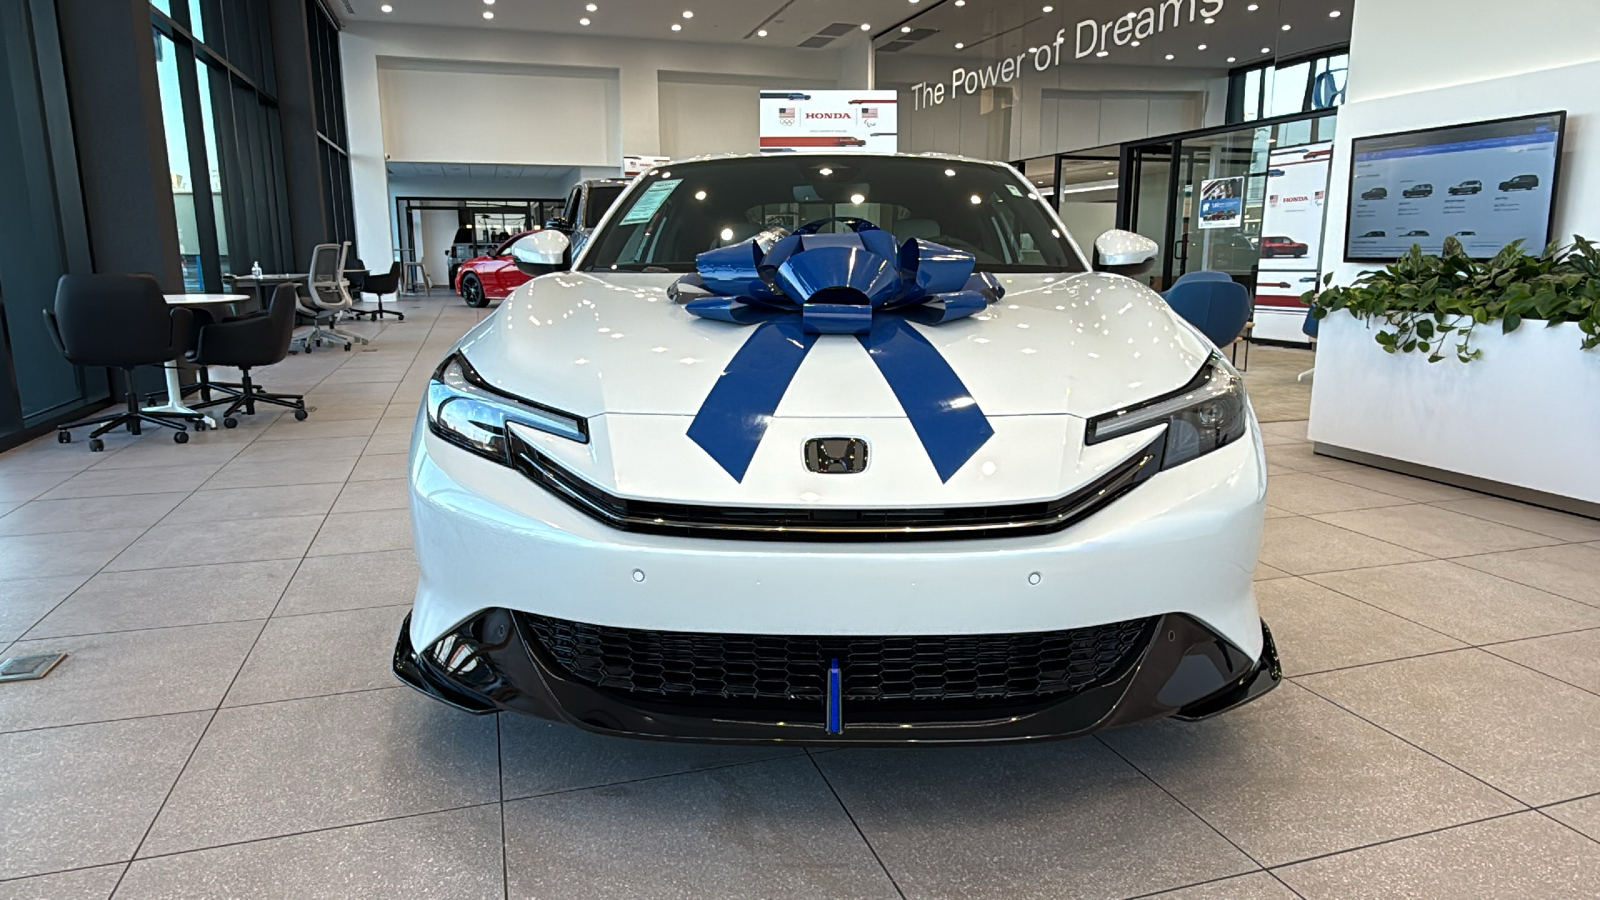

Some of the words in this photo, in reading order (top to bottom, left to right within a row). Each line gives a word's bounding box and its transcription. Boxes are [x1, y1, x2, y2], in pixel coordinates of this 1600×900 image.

[911, 81, 945, 111] The
[952, 57, 1026, 99] Power
[1034, 28, 1065, 71] of
[1075, 0, 1224, 59] Dreams
